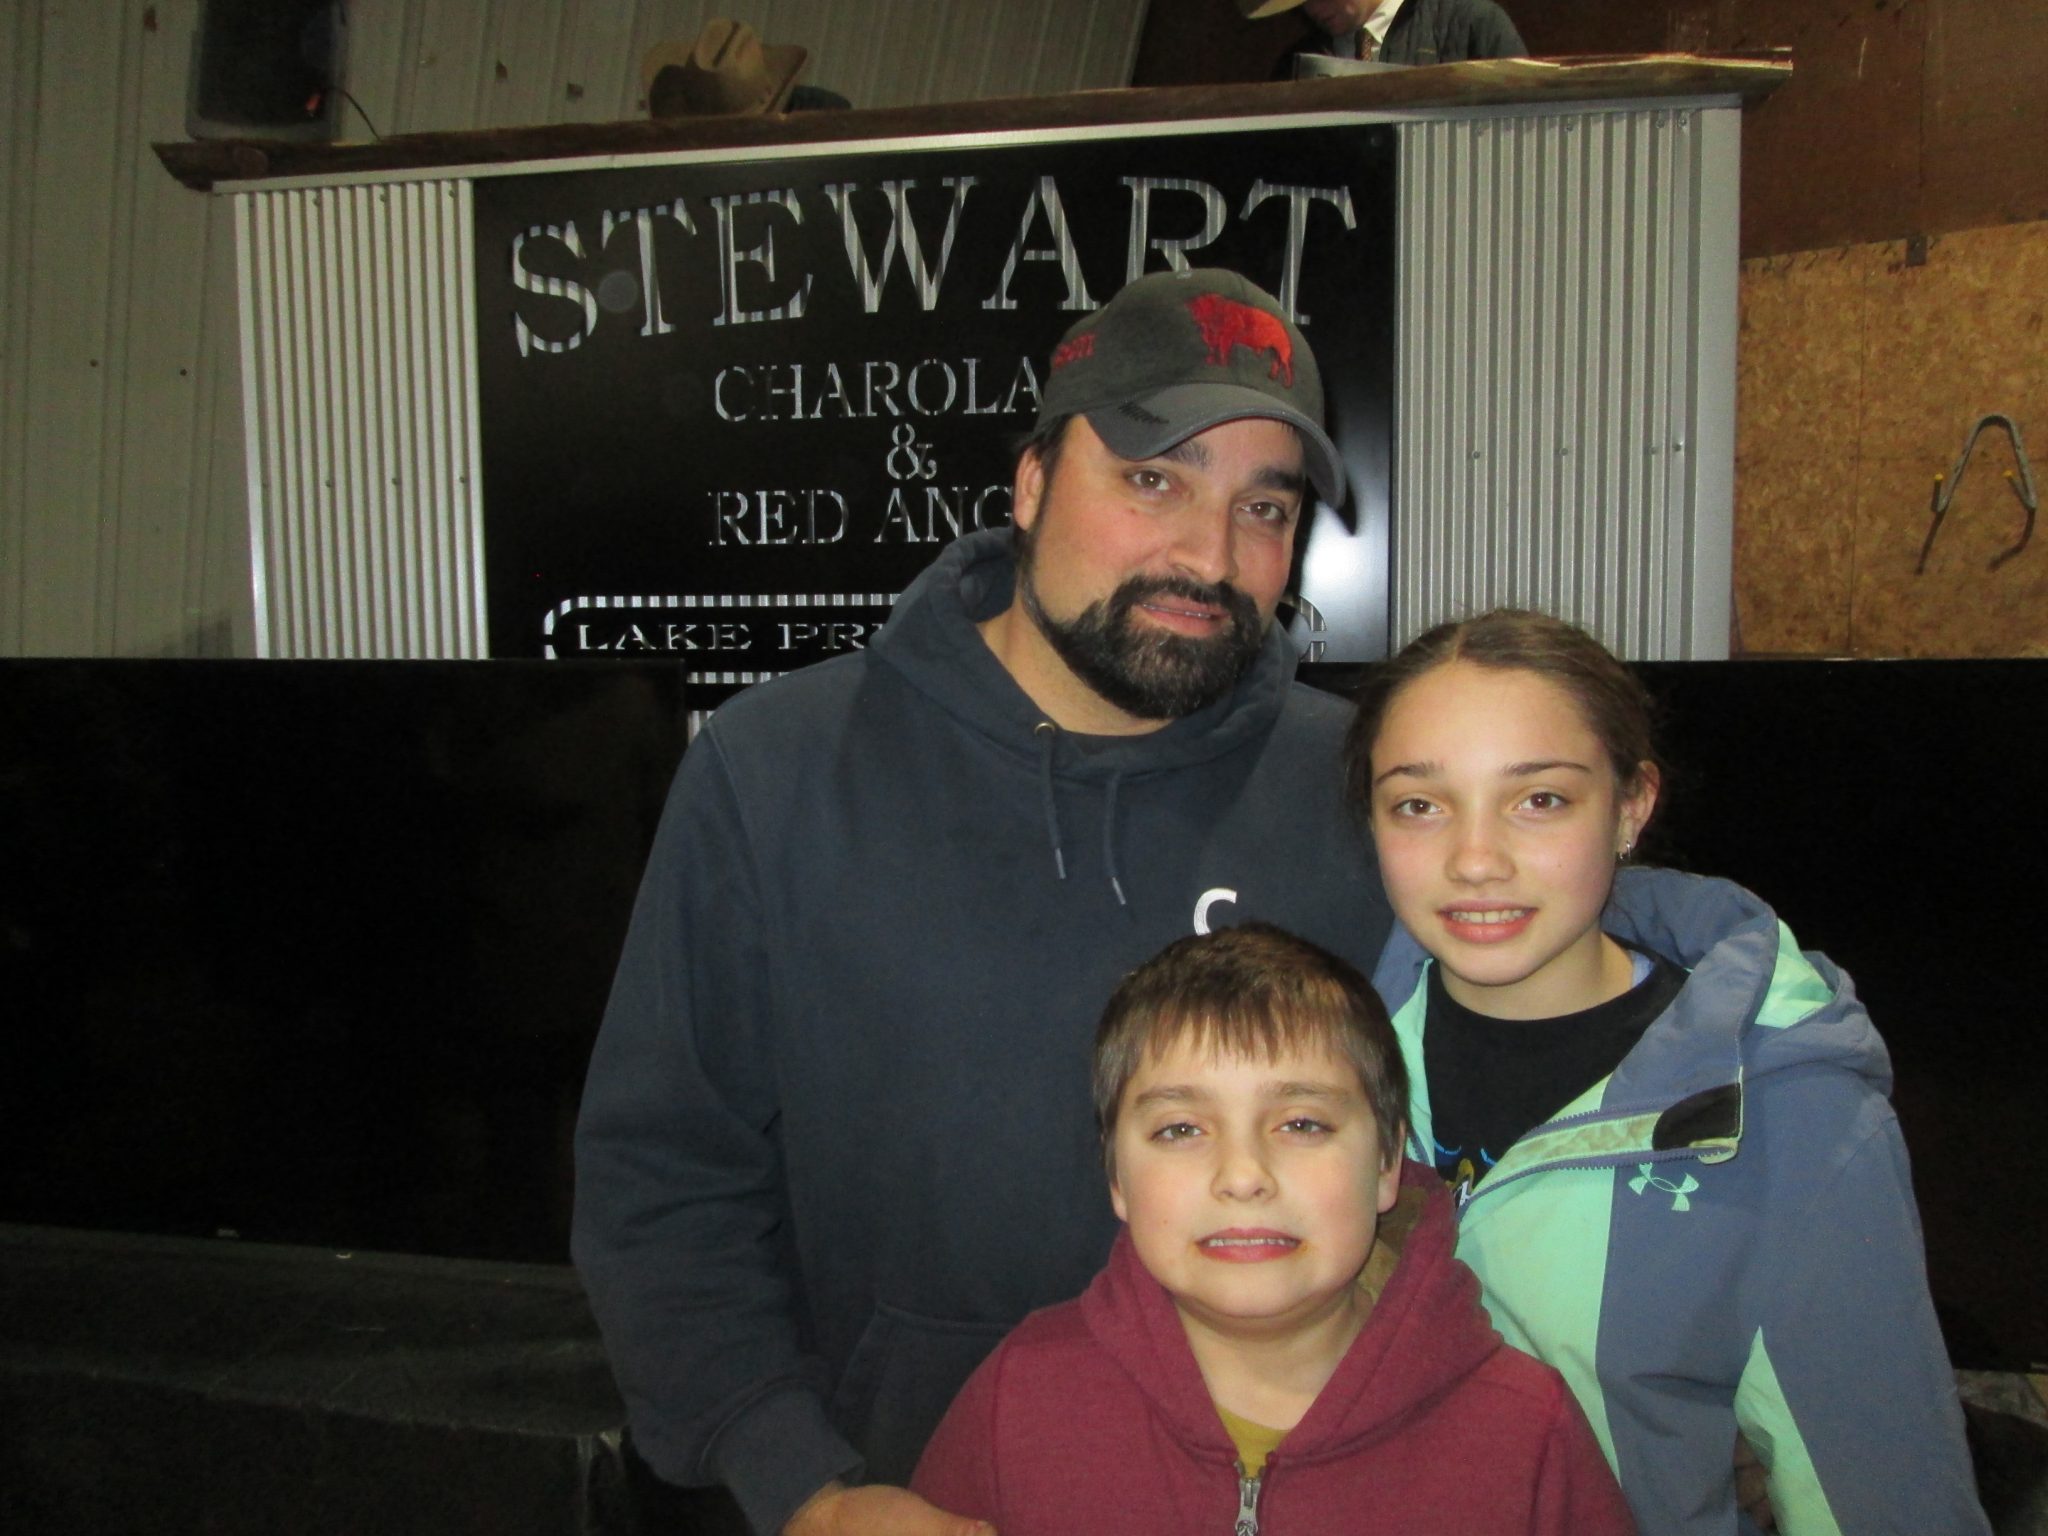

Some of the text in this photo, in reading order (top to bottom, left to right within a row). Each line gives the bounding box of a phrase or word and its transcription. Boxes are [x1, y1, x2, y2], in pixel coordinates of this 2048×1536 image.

[511, 175, 1357, 359] STEWART
[714, 355, 1044, 422] CHAROLA
[887, 422, 938, 480] &
[708, 485, 1014, 545] RED ANG
[578, 622, 883, 651] LAKE PR
